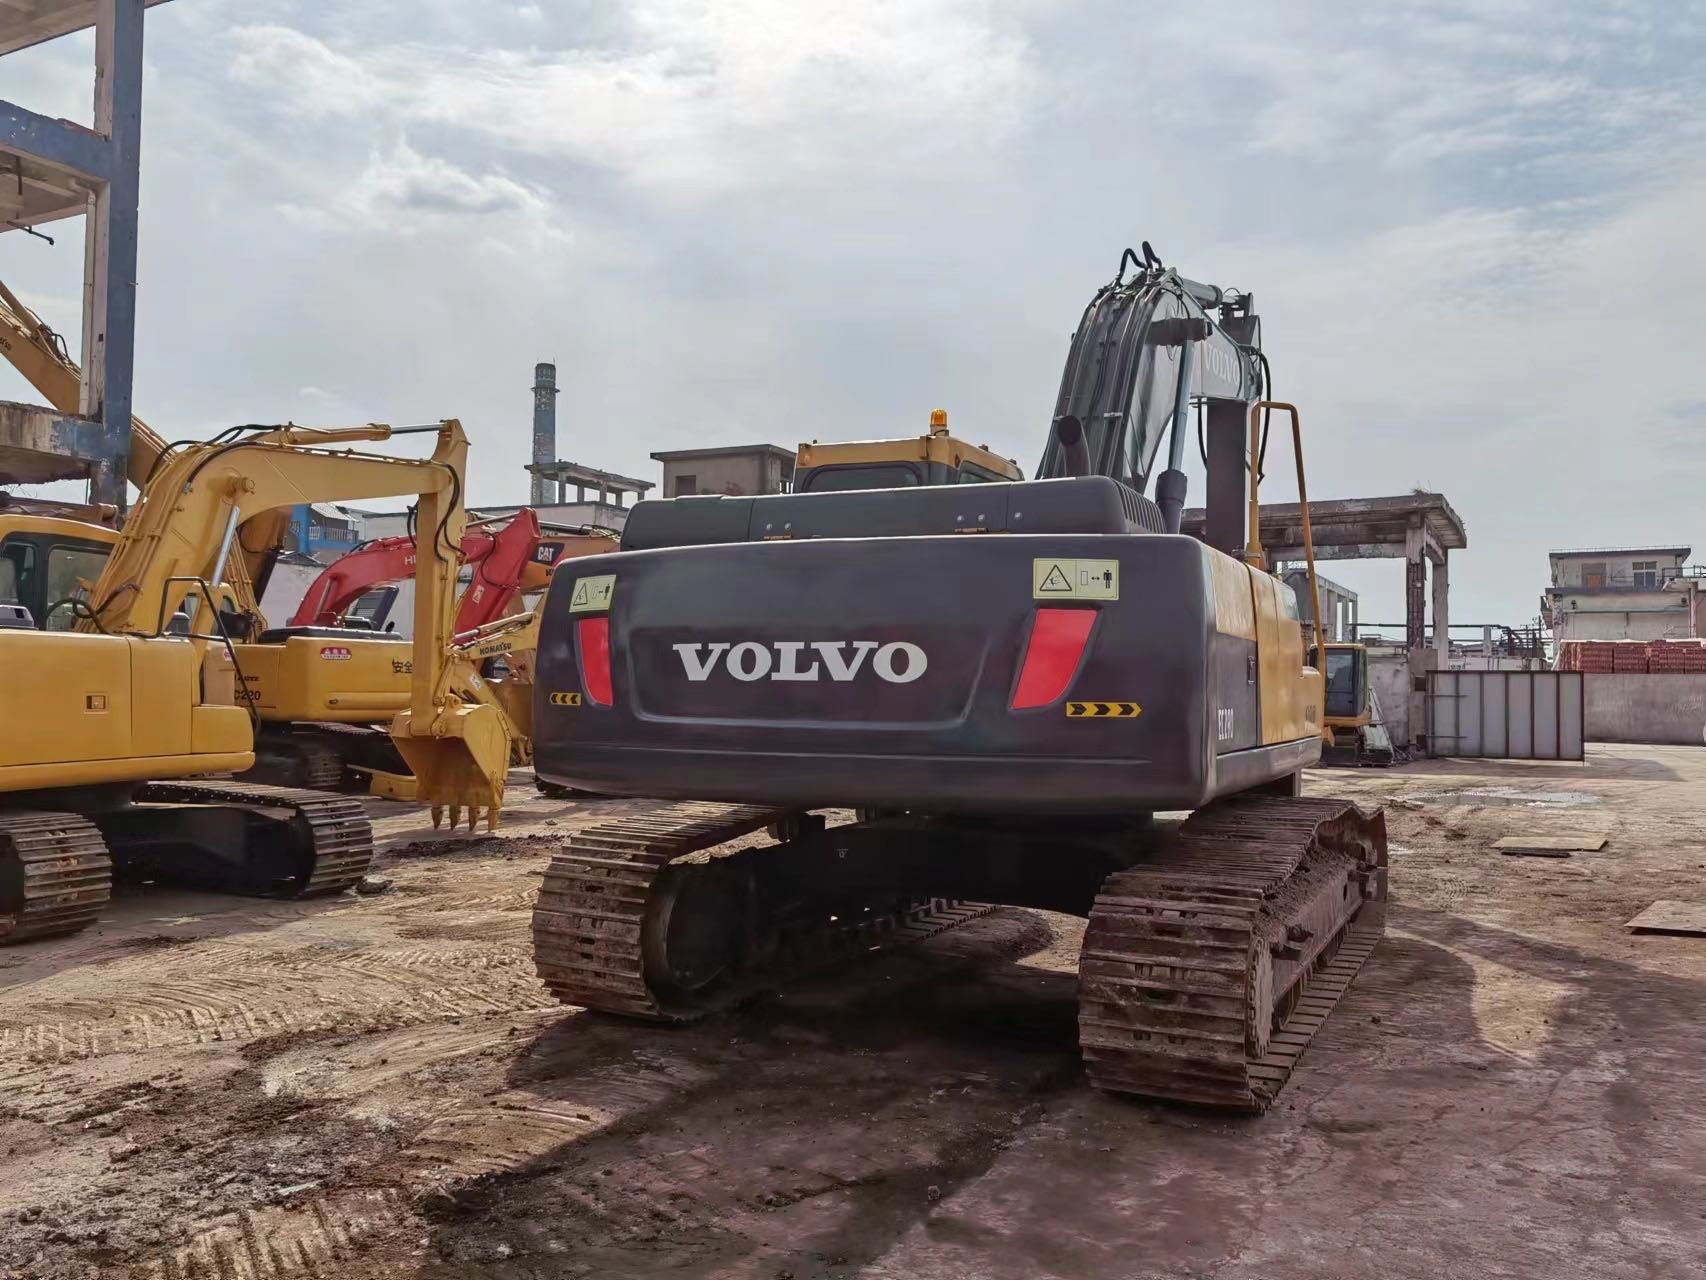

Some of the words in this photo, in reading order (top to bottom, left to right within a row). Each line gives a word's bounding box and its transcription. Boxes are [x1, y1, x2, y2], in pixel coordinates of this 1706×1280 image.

[1204, 342, 1240, 385] VOLVO
[538, 546, 555, 561] CAT
[479, 642, 512, 656] KOMATSU
[672, 641, 928, 683] VOLVO
[234, 689, 261, 700] C220
